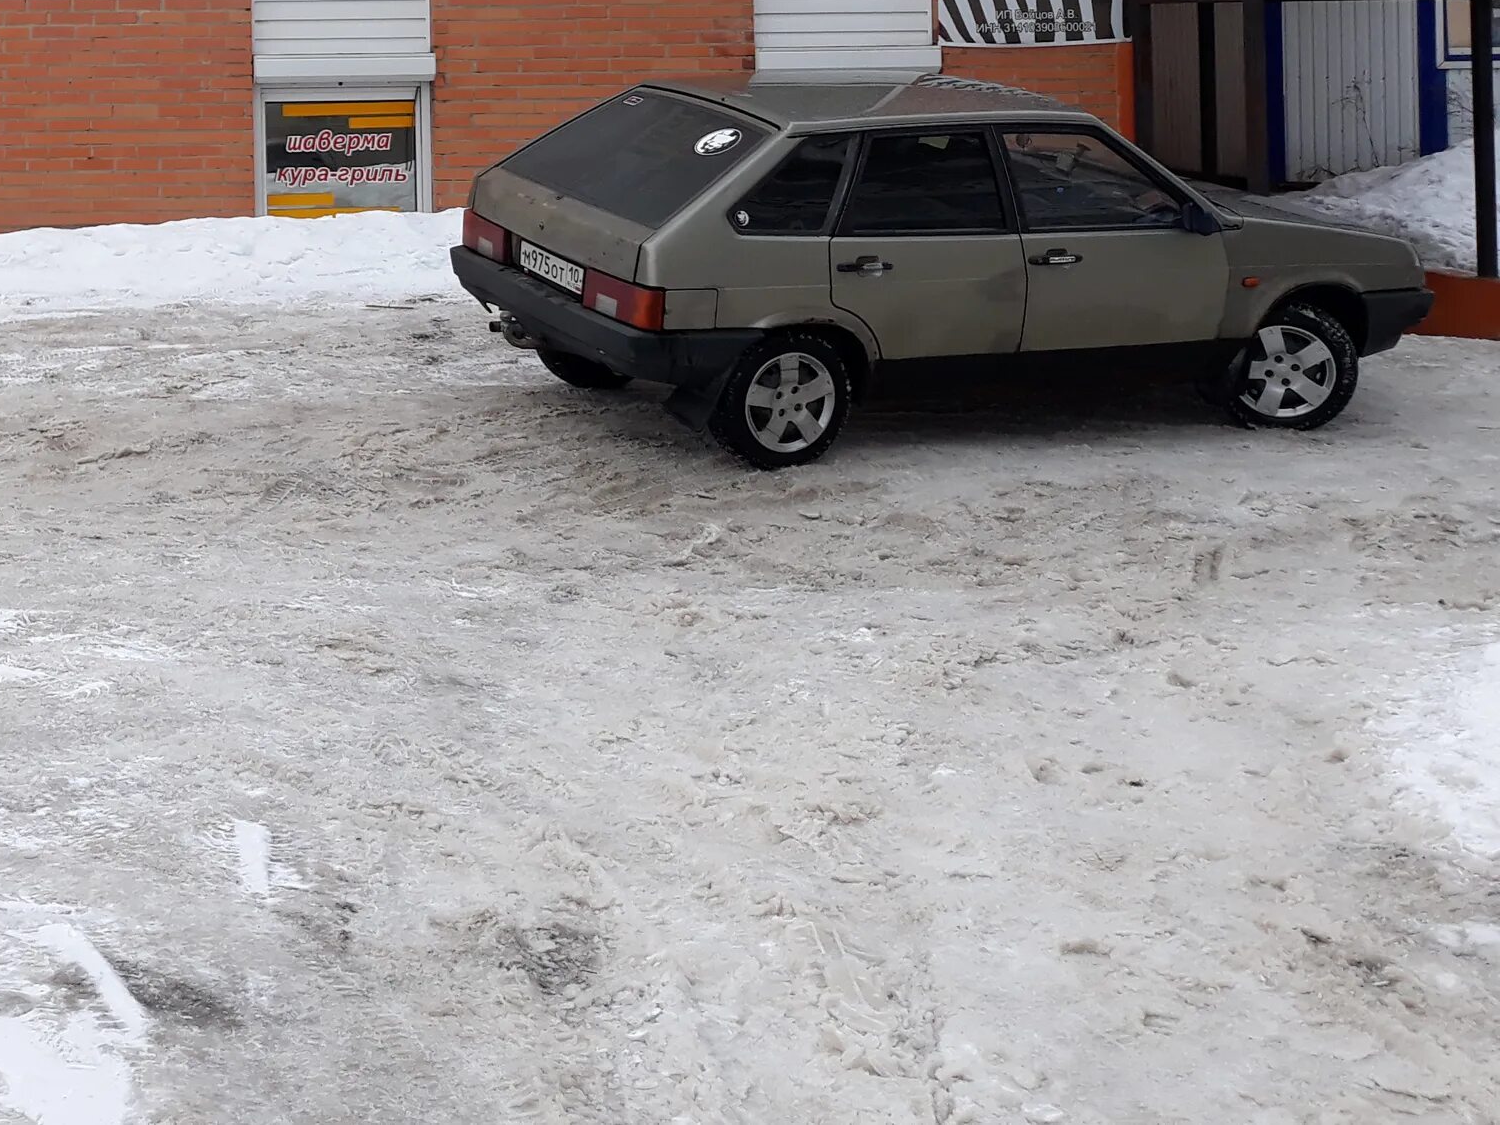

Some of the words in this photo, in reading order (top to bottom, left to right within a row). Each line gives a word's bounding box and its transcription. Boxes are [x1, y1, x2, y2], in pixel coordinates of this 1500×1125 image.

[995, 9, 1013, 20] ИП
[976, 23, 1001, 34] ИНН
[286, 129, 392, 156] шаверма
[276, 166, 408, 187] кура-гриль
